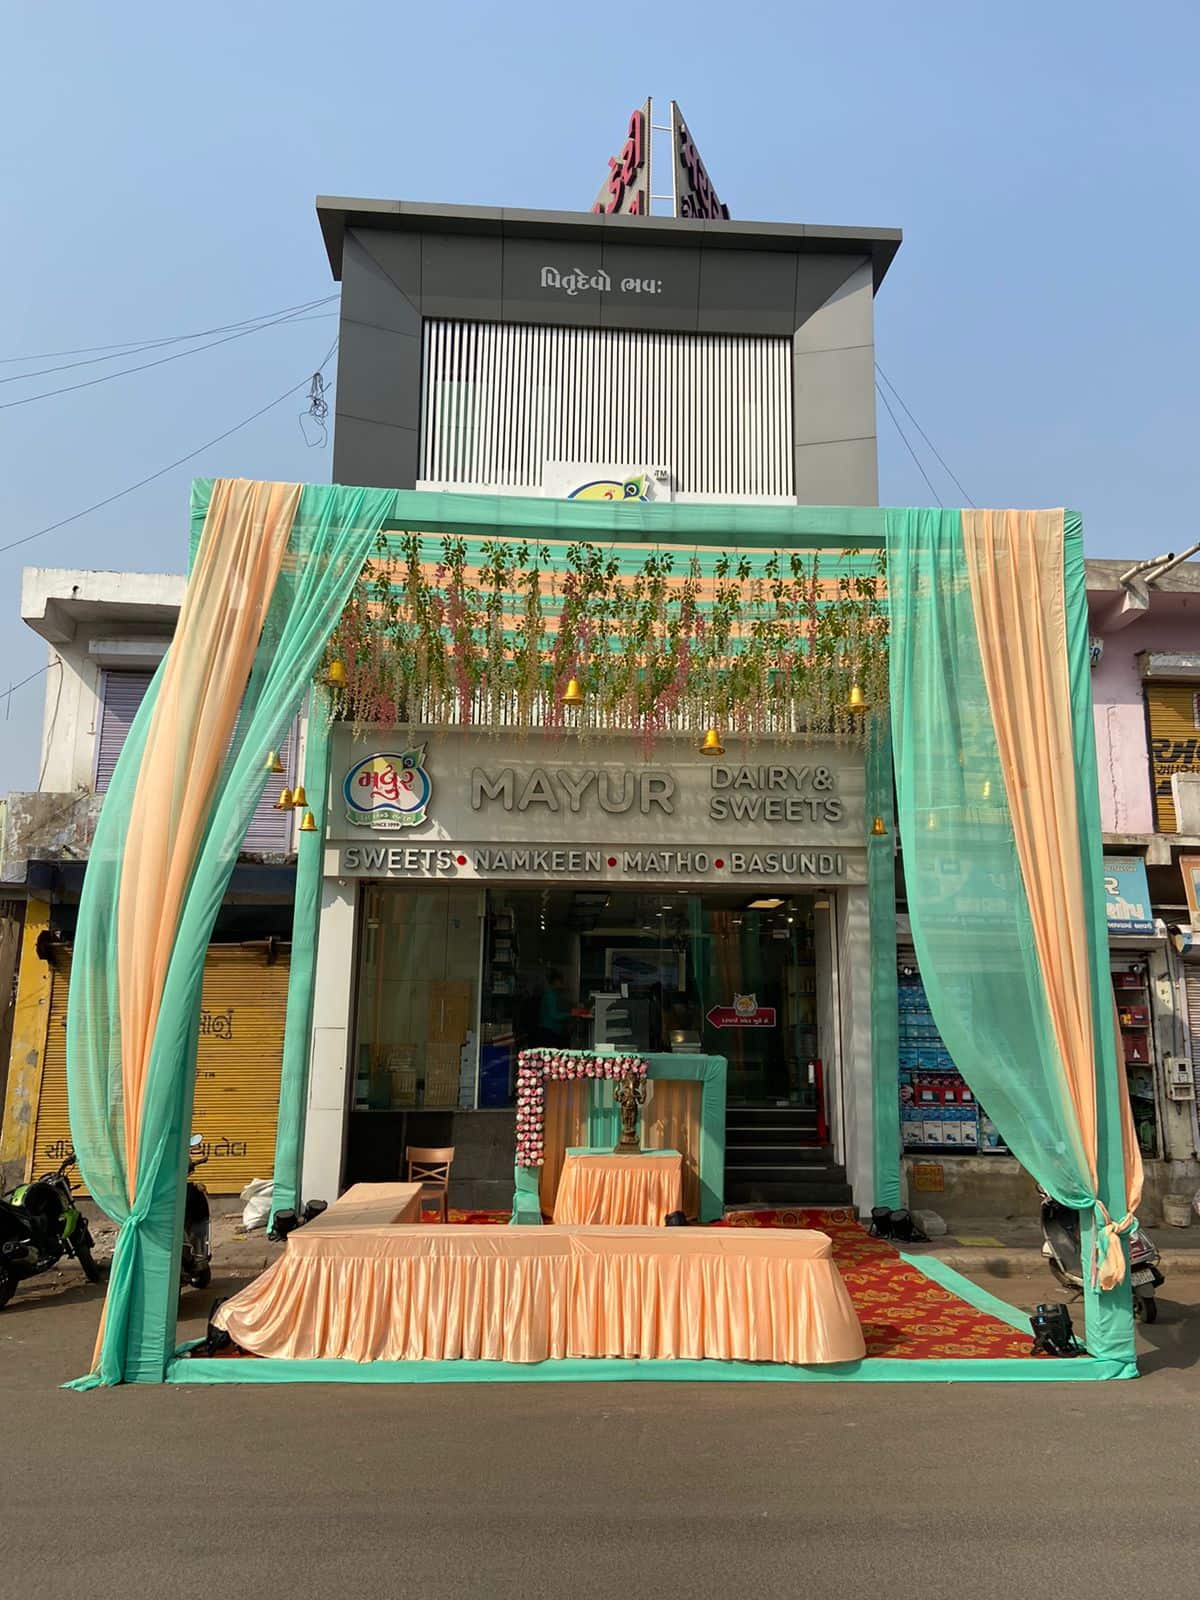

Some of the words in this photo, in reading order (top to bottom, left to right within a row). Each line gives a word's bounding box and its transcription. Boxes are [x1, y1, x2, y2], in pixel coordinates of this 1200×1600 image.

[540, 266, 612, 296] પિતૃદેવો
[470, 766, 677, 814] MAYUR
[708, 795, 843, 823] SWEETS
[345, 848, 452, 871] SWEETS
[473, 849, 601, 873] NAMKEEN
[622, 851, 710, 874] MATHO
[729, 852, 844, 875] BASUNDI
